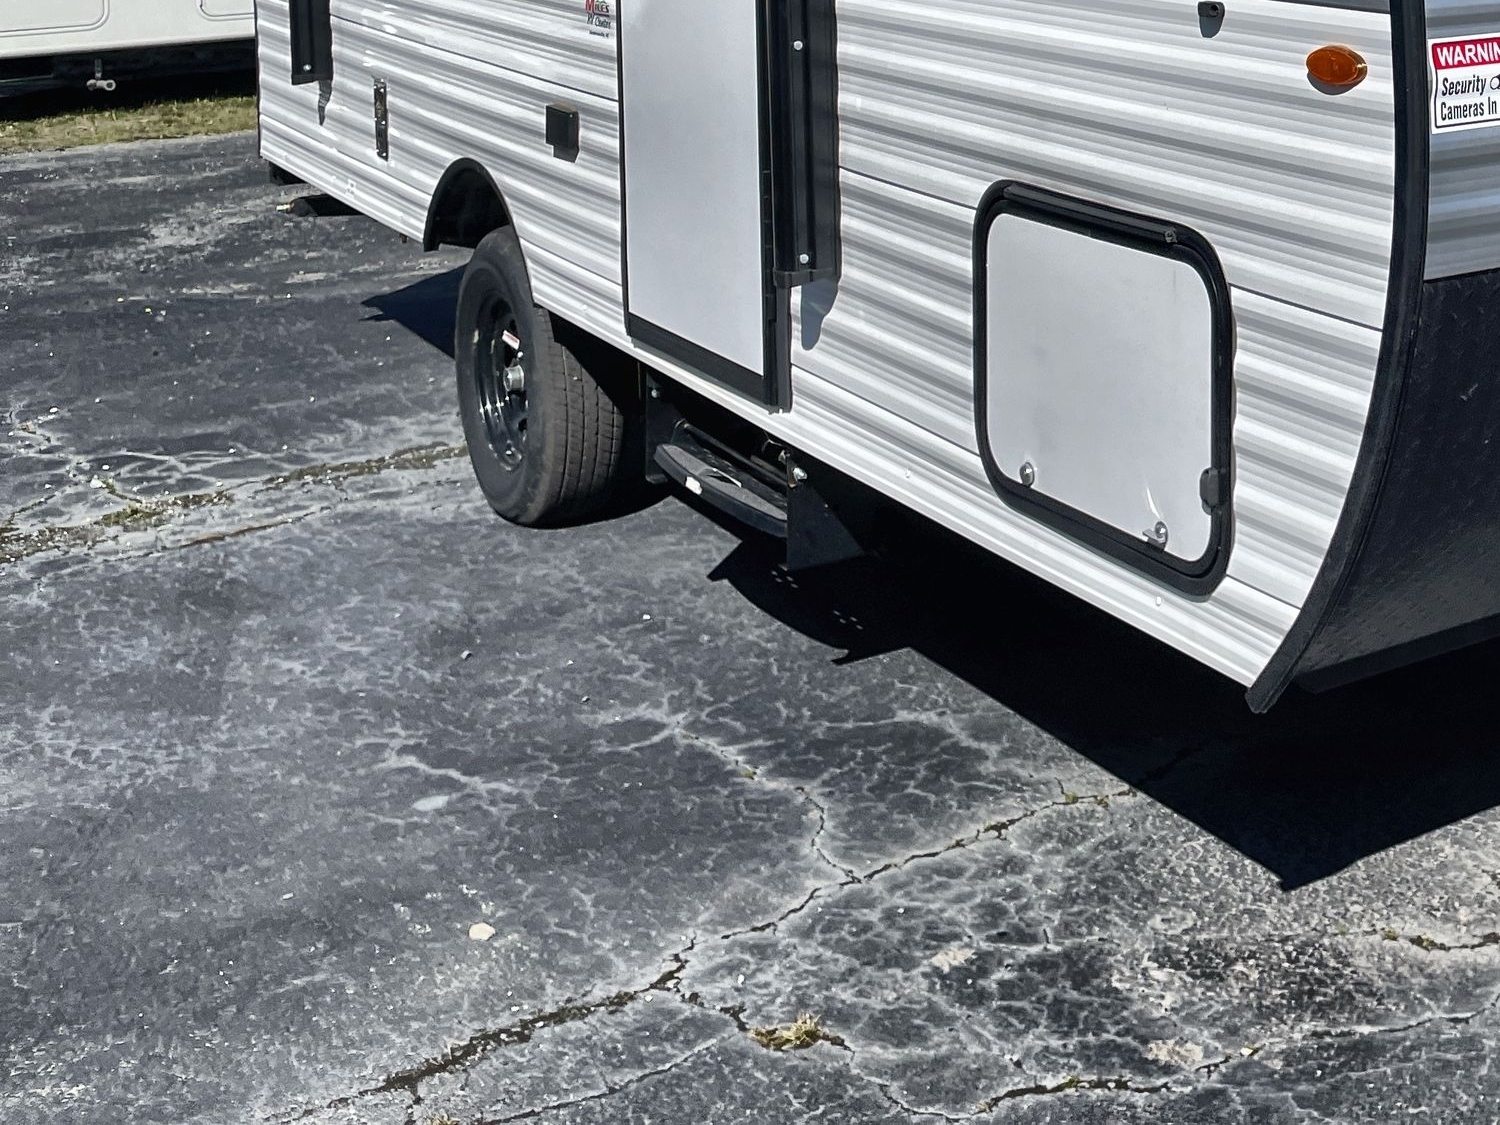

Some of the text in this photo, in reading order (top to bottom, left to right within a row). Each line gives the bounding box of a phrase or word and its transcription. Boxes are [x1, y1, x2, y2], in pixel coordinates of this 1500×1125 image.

[1441, 74, 1487, 96] Security
[1440, 101, 1485, 122] Cameras
[1487, 96, 1498, 116] In
